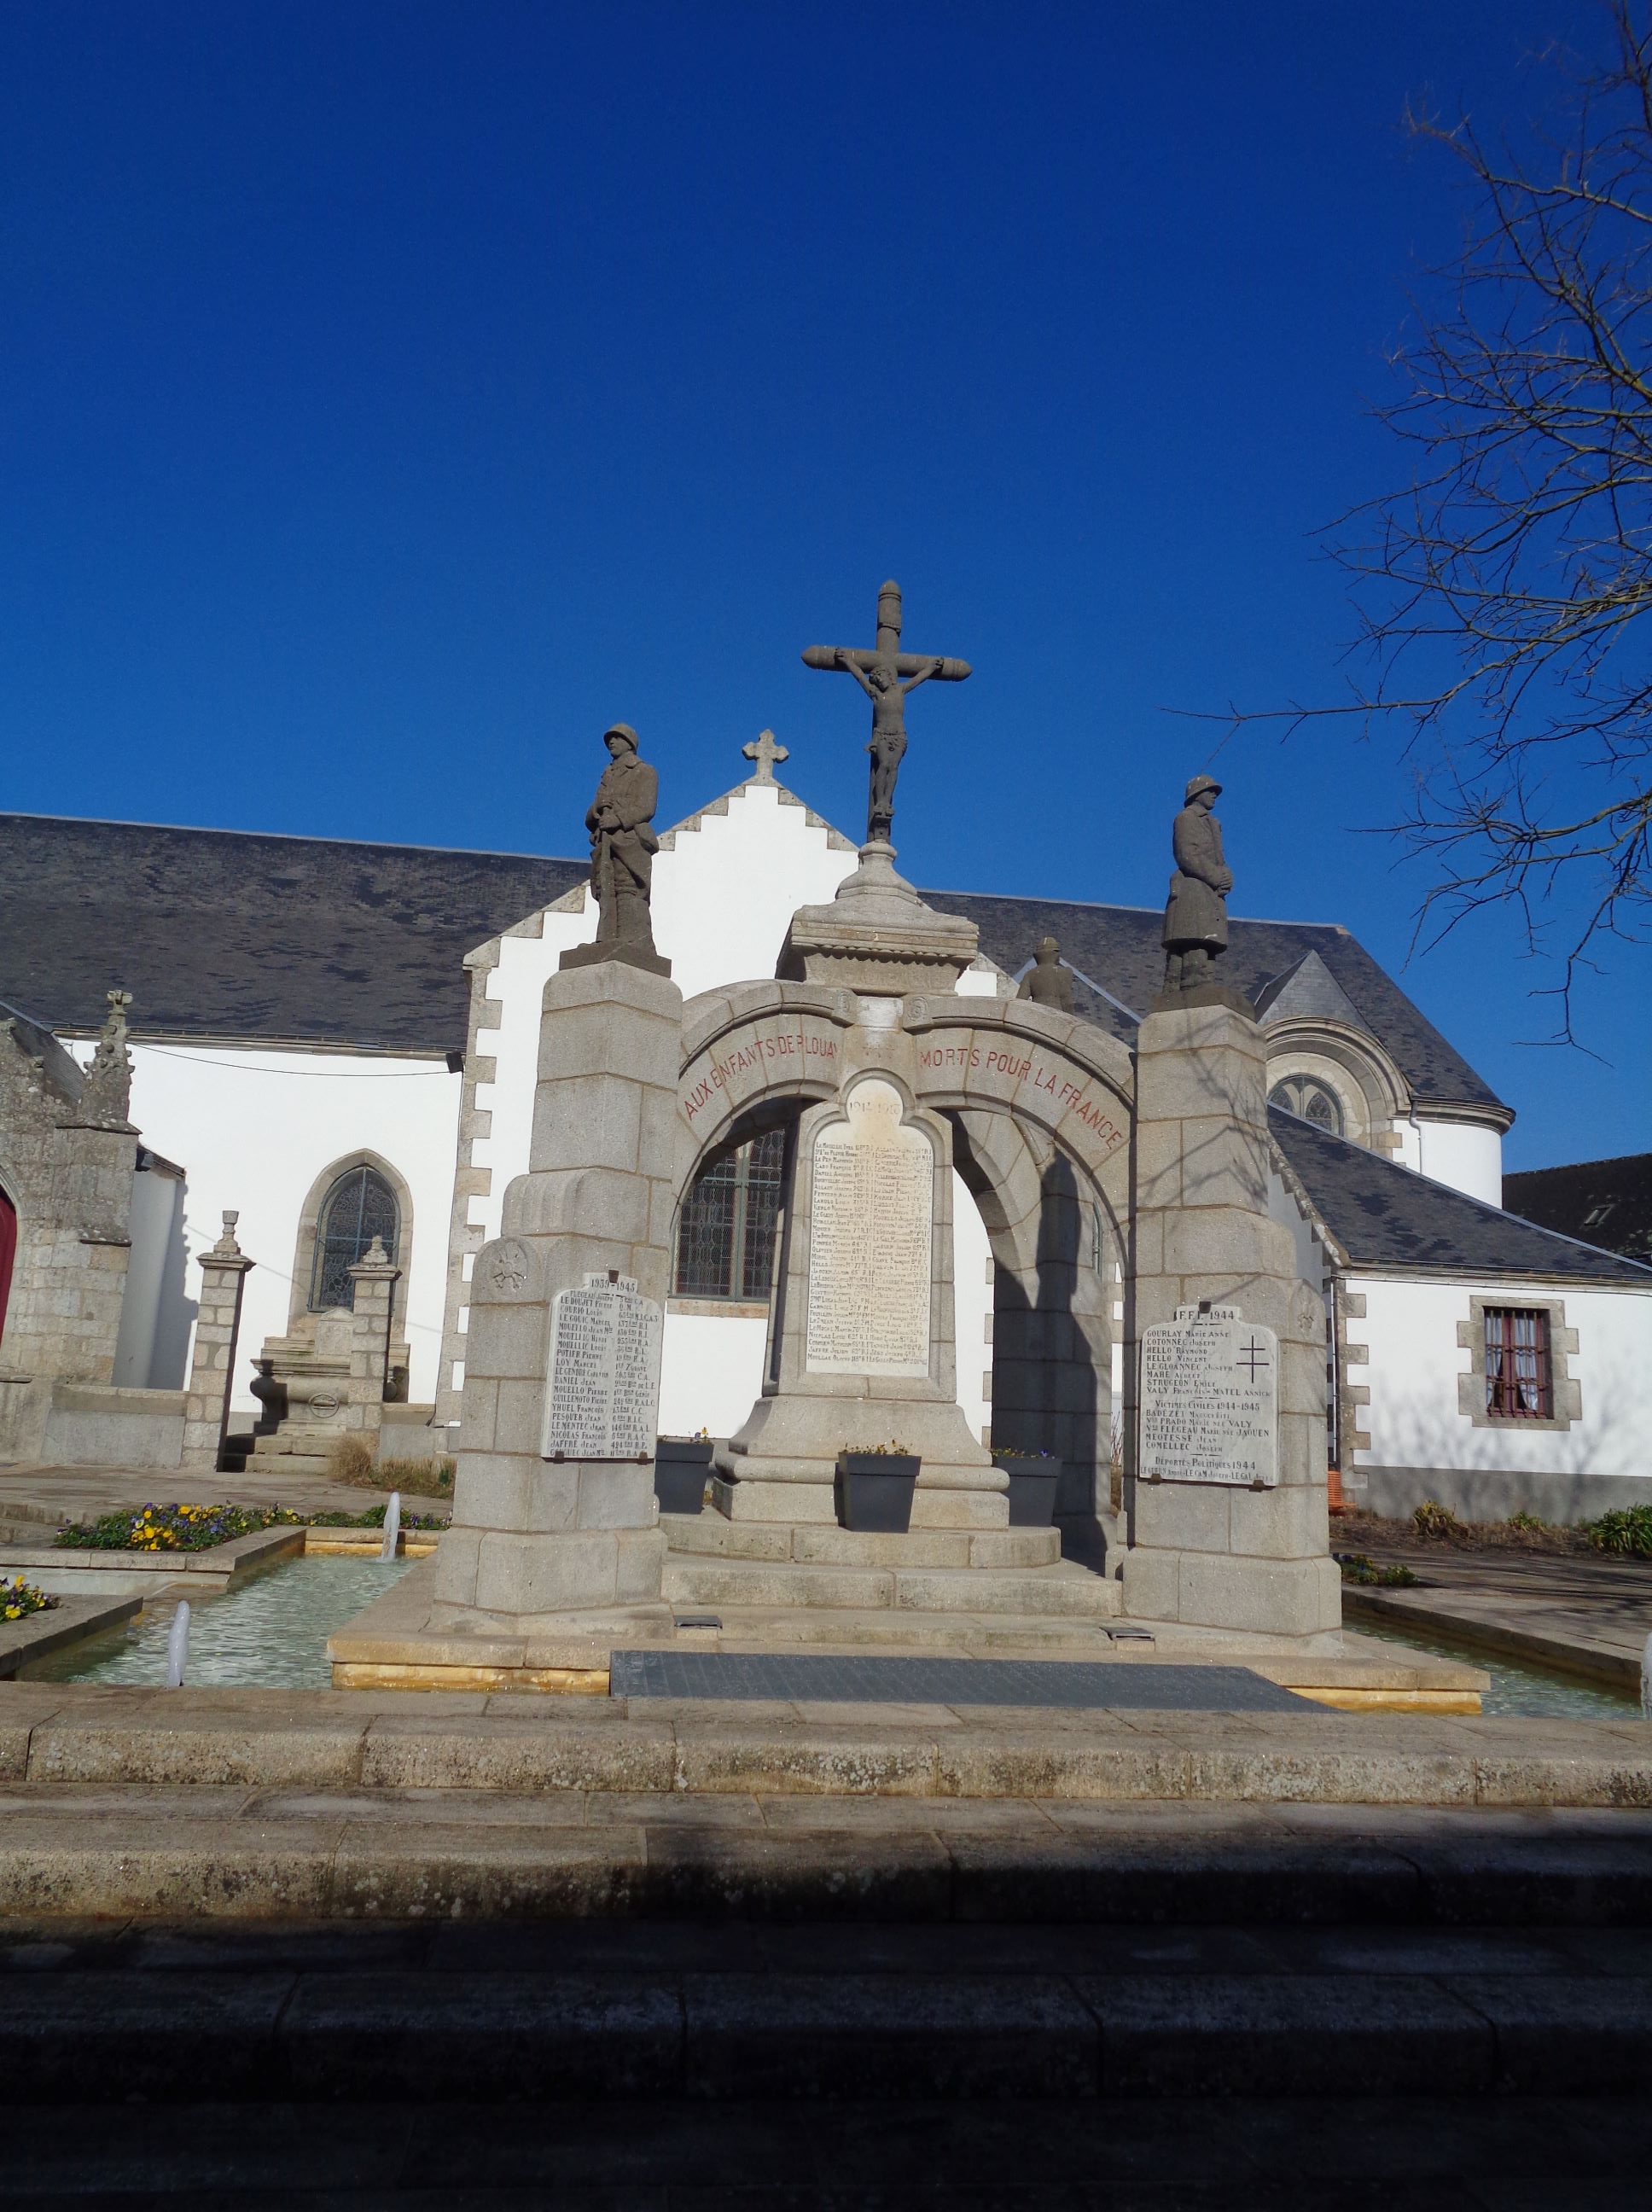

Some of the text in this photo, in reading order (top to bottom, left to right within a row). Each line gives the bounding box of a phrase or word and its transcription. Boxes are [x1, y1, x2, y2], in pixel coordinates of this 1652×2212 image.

[684, 1079, 713, 1121] AUX
[710, 1039, 776, 1088] ENFANTS
[778, 1035, 794, 1054] DE
[920, 1049, 980, 1069] MORTS
[986, 1051, 1032, 1080] POUR
[1034, 1068, 1057, 1094] LA
[1058, 1083, 1122, 1150] FRANCE
[591, 1279, 635, 1292] 1939-1945
[1210, 1311, 1234, 1320] 1944
[556, 1358, 569, 1366] LOY
[581, 1377, 596, 1386] JEAN
[554, 1386, 584, 1394] MOUELLO
[553, 1404, 573, 1412] YHUEL
[1155, 1400, 1186, 1409] VICTIMES
[1189, 1400, 1214, 1409] CIVILES
[553, 1413, 582, 1422] PESQUER
[1236, 1429, 1270, 1437] JAOUEN
[1147, 1441, 1190, 1450] COMELLEC
[1233, 1461, 1255, 1470] 1944
